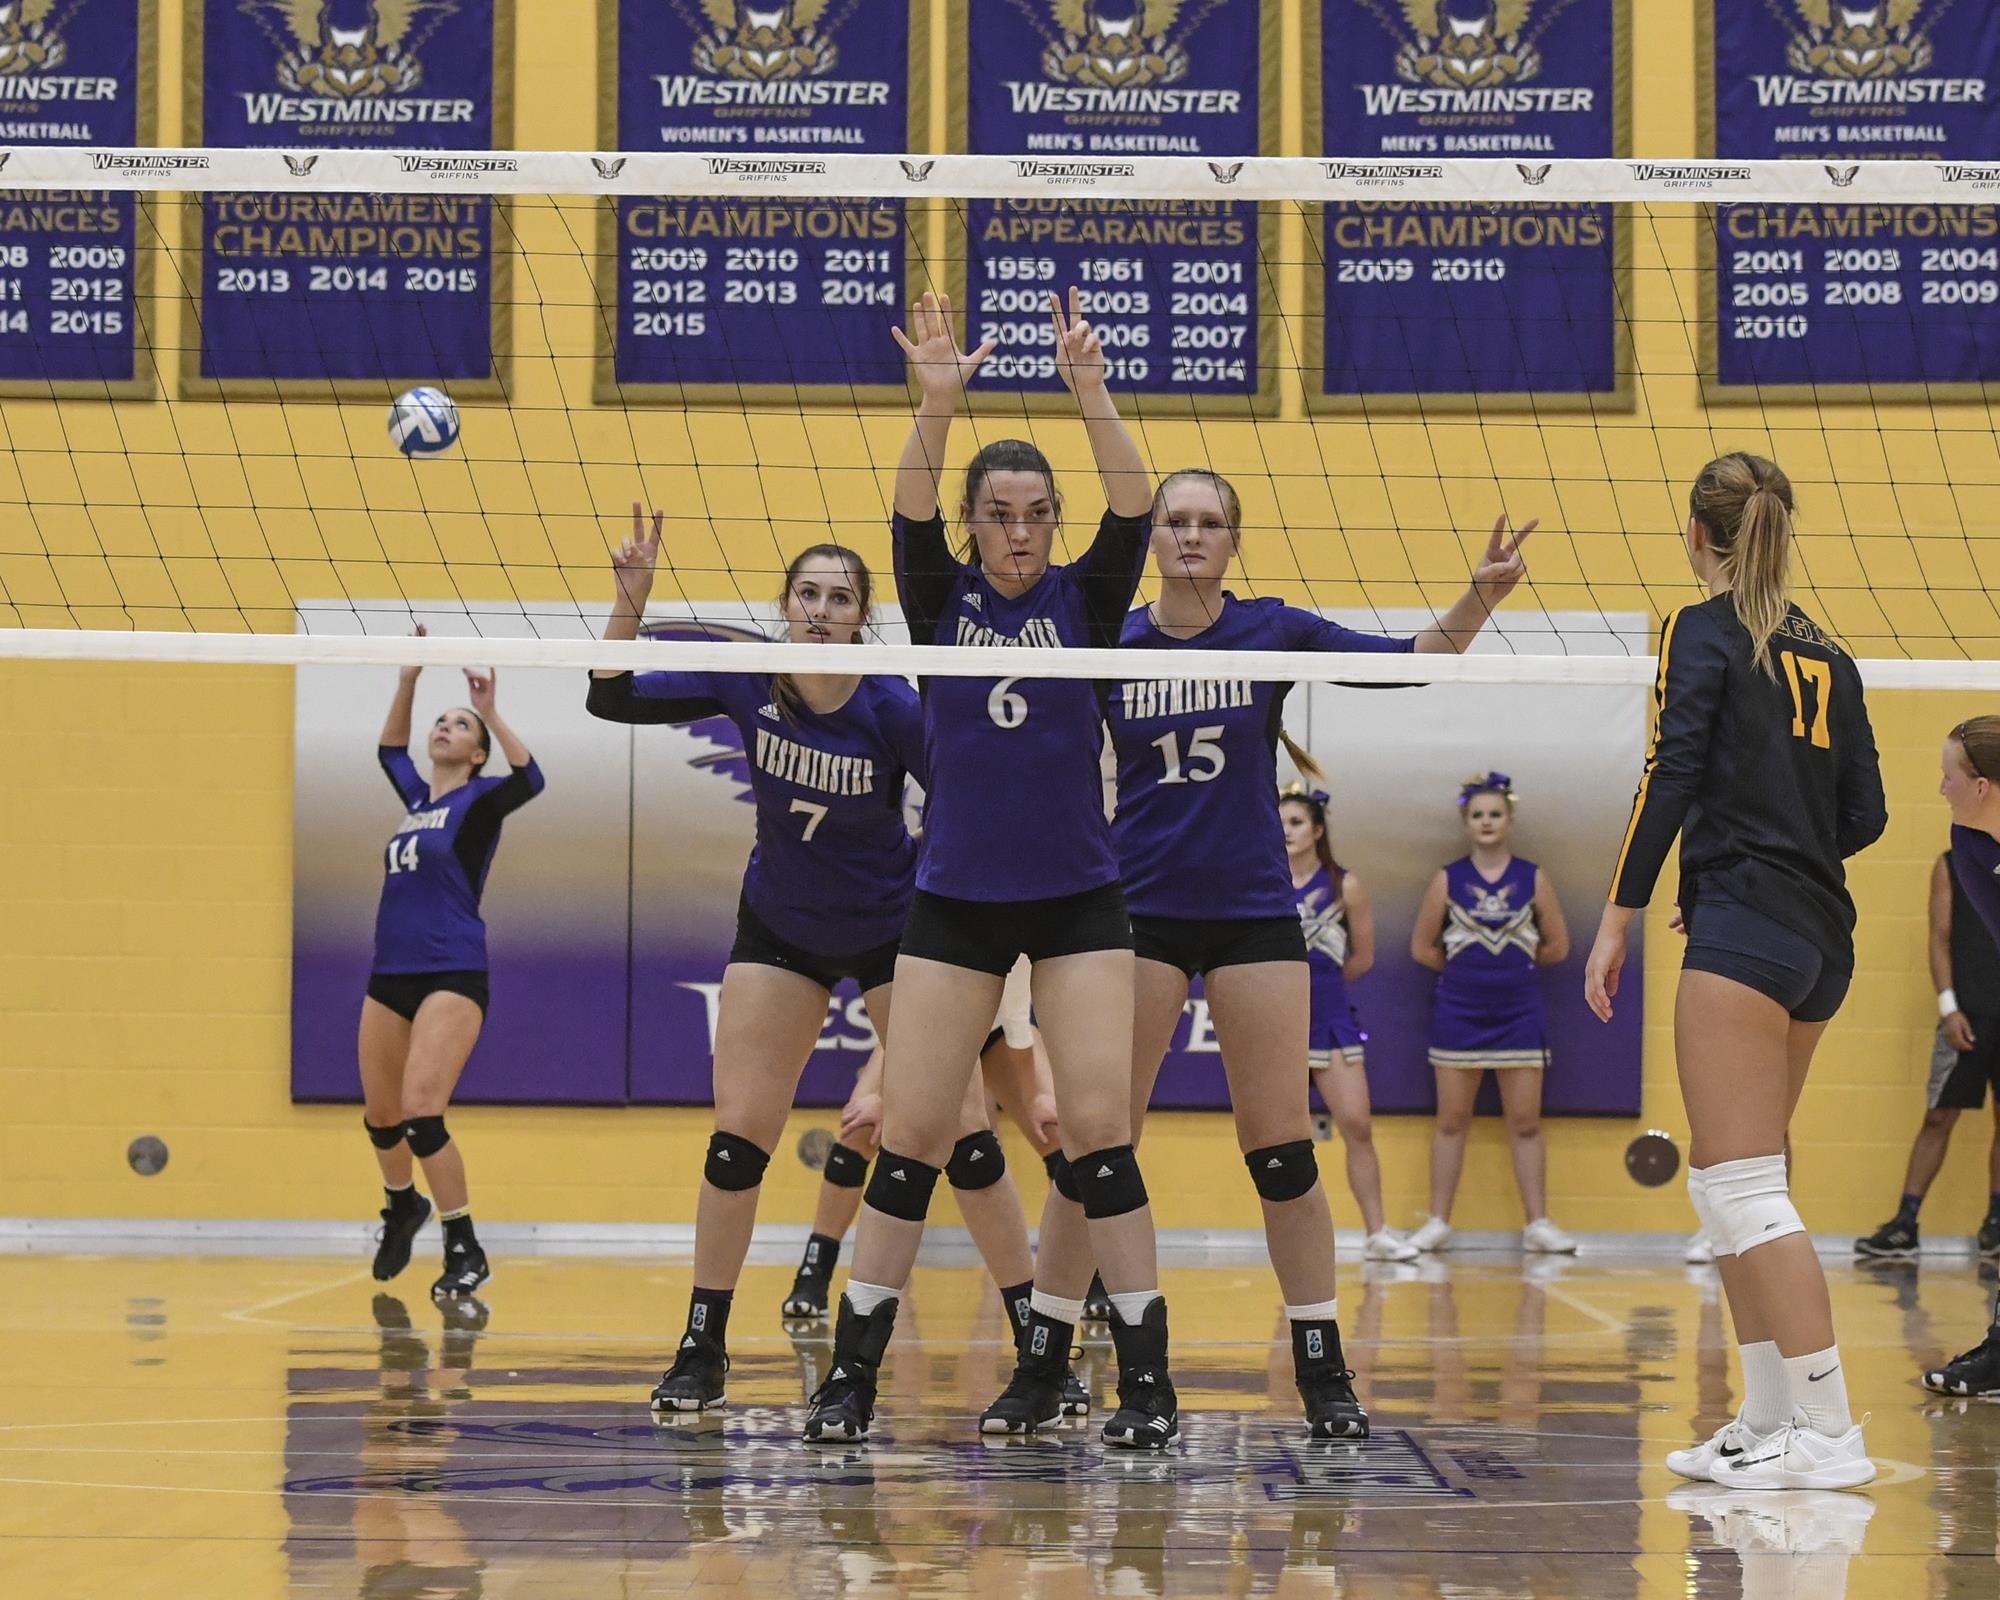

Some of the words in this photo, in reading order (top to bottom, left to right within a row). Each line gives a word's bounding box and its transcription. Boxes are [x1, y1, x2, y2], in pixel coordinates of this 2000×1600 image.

[0, 76, 117, 101] INSTER
[656, 75, 889, 107] WESTMINSTER
[1005, 81, 1240, 114] WESTMINSTER
[1361, 84, 1594, 116] WESTMINSTER
[1753, 75, 1985, 107] WESTMINSTER
[241, 92, 475, 124] WESTMINSTER
[661, 126, 748, 144] WOMEN'S
[754, 127, 865, 144] BASKETBALL
[1028, 134, 1084, 151] MEN'S
[1089, 135, 1200, 152] BASKETBALL
[1381, 135, 1438, 152] MEN'S
[1443, 135, 1554, 152] BASKETBALL
[1774, 126, 1831, 142] MEN'S
[1837, 126, 1947, 142] BASKETBALL
[88, 153, 210, 170] WESTMINSTER
[122, 169, 172, 177] GRIFFINS
[396, 155, 519, 172] WESTMINSTER
[703, 158, 827, 174] WESTMINSTER
[1011, 161, 1135, 177] WESTMINSTER
[1320, 163, 1443, 179] WESTMINSTER
[1629, 164, 1752, 180] WESTMINSTER
[430, 171, 480, 179] GRIFFINS
[738, 174, 788, 182] GRIFFINS
[1047, 176, 1097, 184] GRIFFINS
[1355, 178, 1405, 186] GRIFFINS
[1664, 180, 1713, 188] GRIFFINS
[212, 195, 482, 223] TOURNAMENT
[627, 206, 897, 240] CHAMPIONS
[983, 219, 1244, 246] APPEARANCES
[1334, 216, 1605, 248] CHAMPIONS
[1728, 206, 1998, 239] CHAMPIONS
[213, 227, 482, 259] CHAMPIONS
[49, 246, 125, 269] 2009
[630, 248, 707, 271] 2009
[725, 248, 798, 272] 2010
[824, 250, 890, 272] 2011
[1338, 258, 1414, 282] 2009
[1431, 258, 1505, 282] 2010
[1732, 251, 1803, 274] 2001
[1824, 248, 1900, 272] 2003
[1921, 248, 1998, 271] 2004
[217, 269, 290, 292] 2013
[309, 267, 388, 292] 2014
[405, 267, 477, 292] 2015
[984, 258, 1056, 280] 1959
[1079, 259, 1143, 281] 1961
[1172, 261, 1241, 283] 2001
[50, 278, 123, 301] 2012
[632, 280, 706, 303] 2012
[724, 280, 797, 304] 2013
[822, 280, 895, 305] 2014
[980, 289, 1055, 313] 2002
[1078, 289, 1150, 314] 2003
[1171, 292, 1248, 315] 2004
[1732, 283, 1809, 306] 2005
[1824, 281, 1902, 304] 2008
[1921, 280, 1998, 304] 2009
[50, 310, 123, 334] 2015
[633, 312, 705, 336] 2015
[980, 321, 1055, 345] 2005
[1093, 323, 1150, 347] 006
[1171, 325, 1247, 348] 2007
[1734, 315, 1808, 338] 2010
[979, 355, 1056, 379] 2009
[1171, 357, 1245, 381] 2014
[987, 677, 1028, 729] 6
[1122, 679, 1253, 721] WESTMINSTER
[1780, 651, 1831, 749] 17
[757, 727, 873, 795] WESTMINSTER
[1151, 725, 1226, 785] 15
[788, 798, 829, 842] 7
[388, 835, 419, 875] 14
